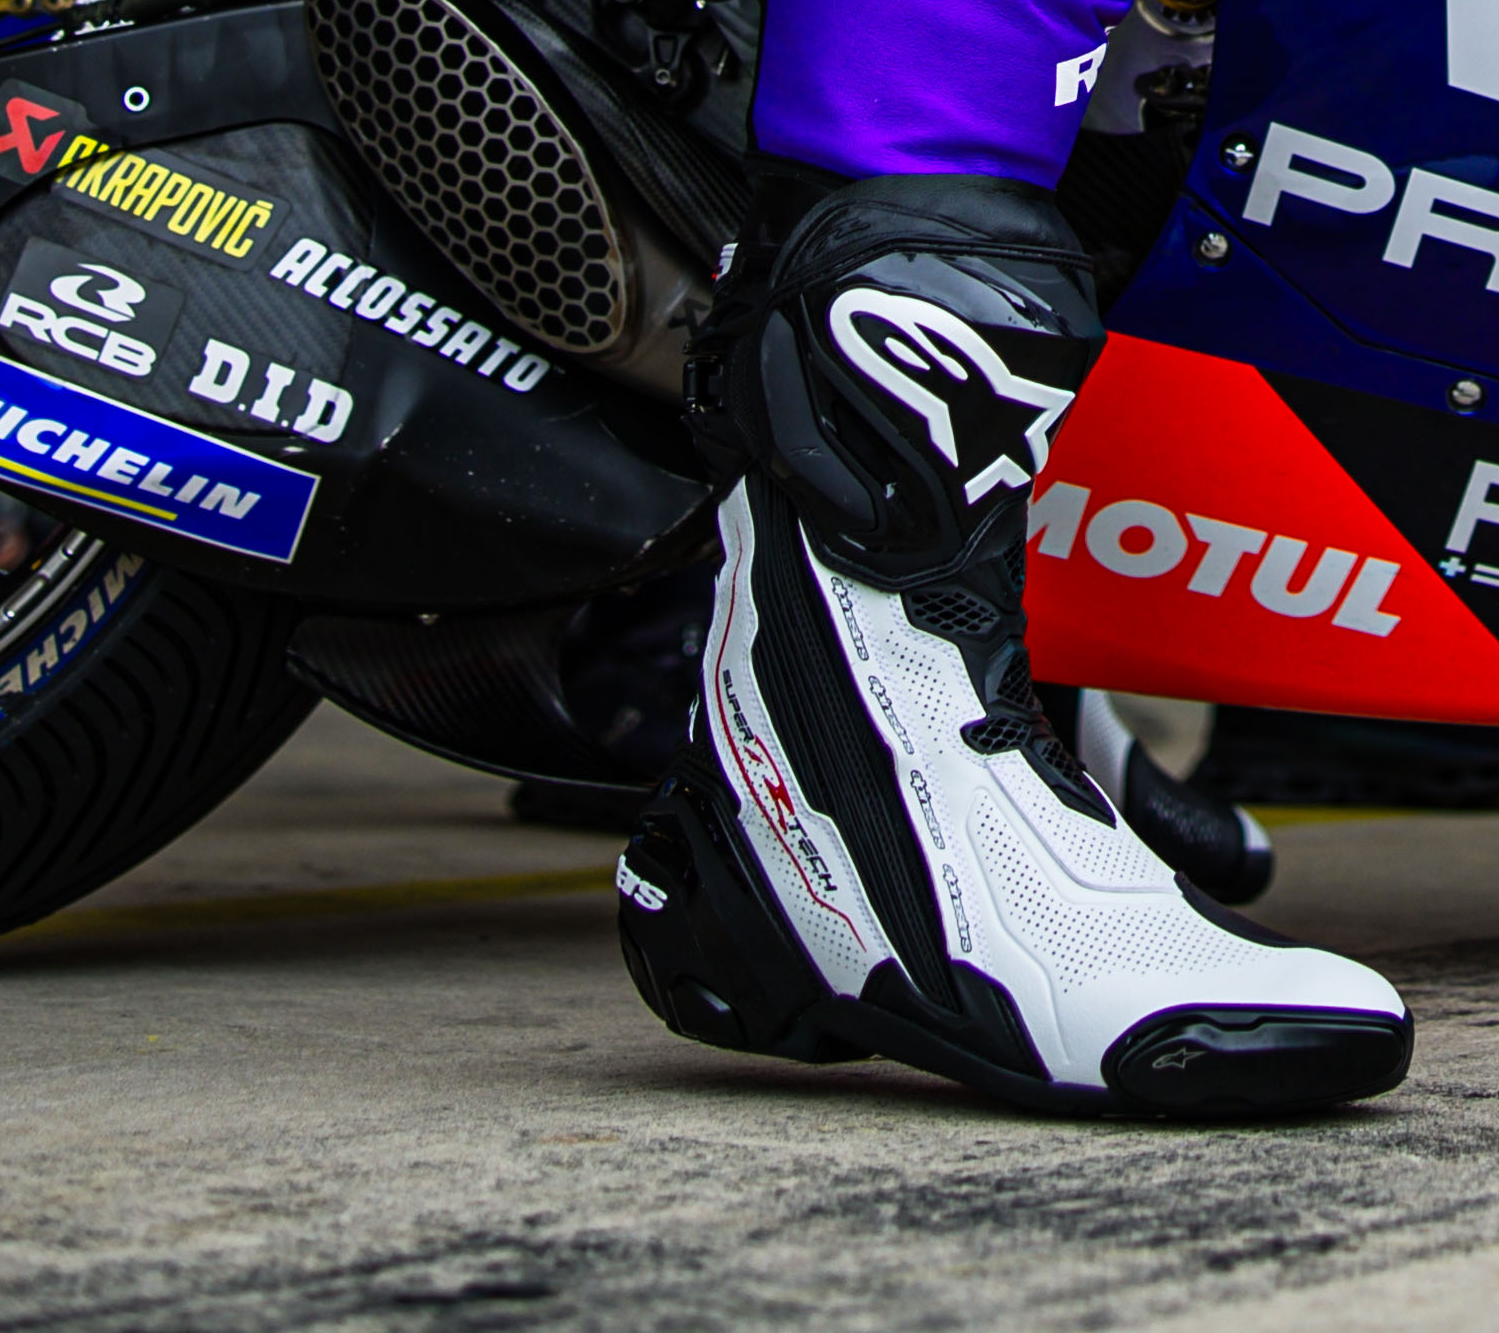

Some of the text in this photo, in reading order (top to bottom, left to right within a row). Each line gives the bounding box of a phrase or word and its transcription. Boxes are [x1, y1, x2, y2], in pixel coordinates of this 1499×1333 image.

[269, 237, 551, 393] ACCOSSATO
[1028, 481, 1401, 637] MOTUL
[722, 669, 755, 742] SUPER
[789, 816, 837, 892] TECH
